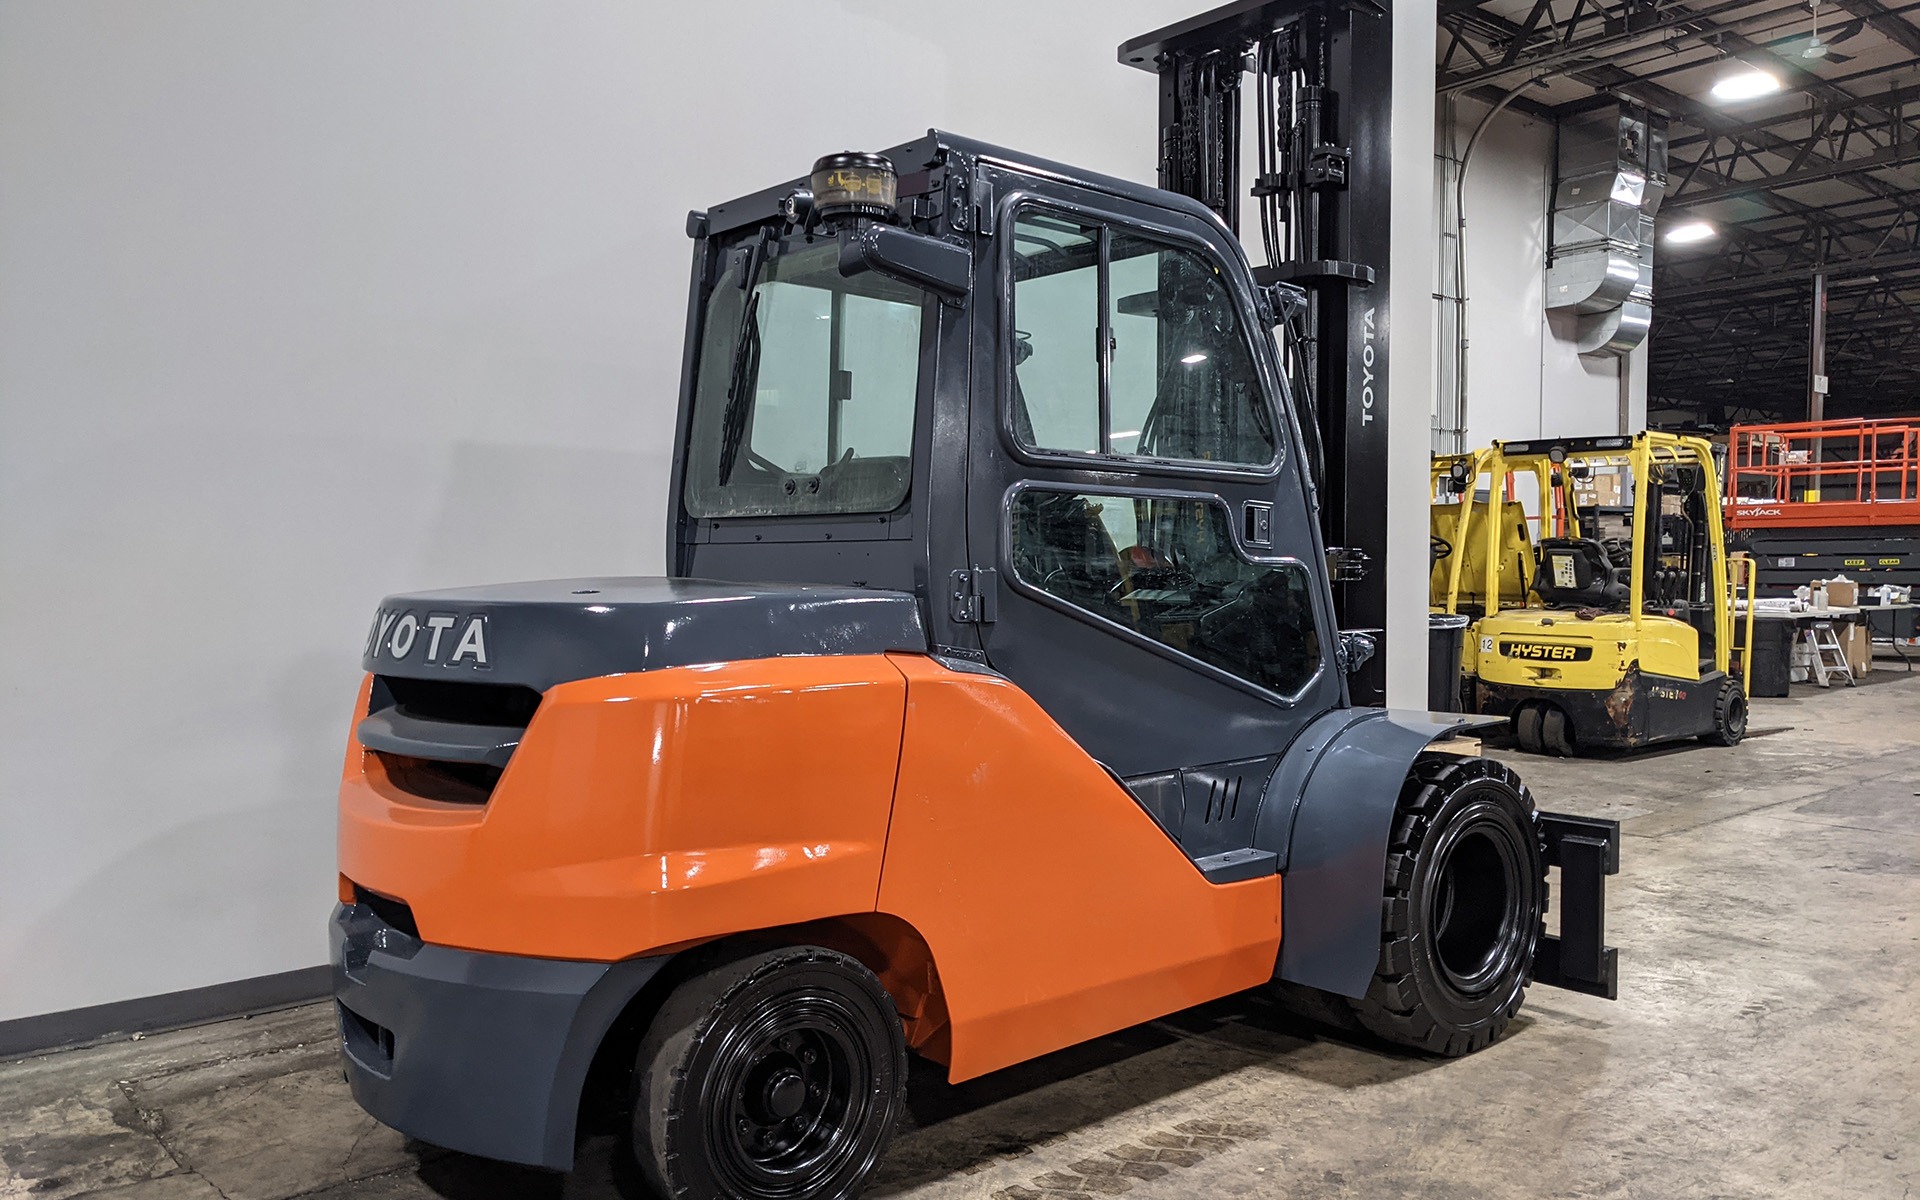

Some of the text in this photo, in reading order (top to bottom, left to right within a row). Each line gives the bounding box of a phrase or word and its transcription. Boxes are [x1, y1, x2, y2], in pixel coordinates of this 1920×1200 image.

[1362, 307, 1376, 426] TOYOTA
[1736, 506, 1782, 517] SKYJACK
[1482, 639, 1493, 650] 12
[1511, 643, 1576, 660] HYSTER
